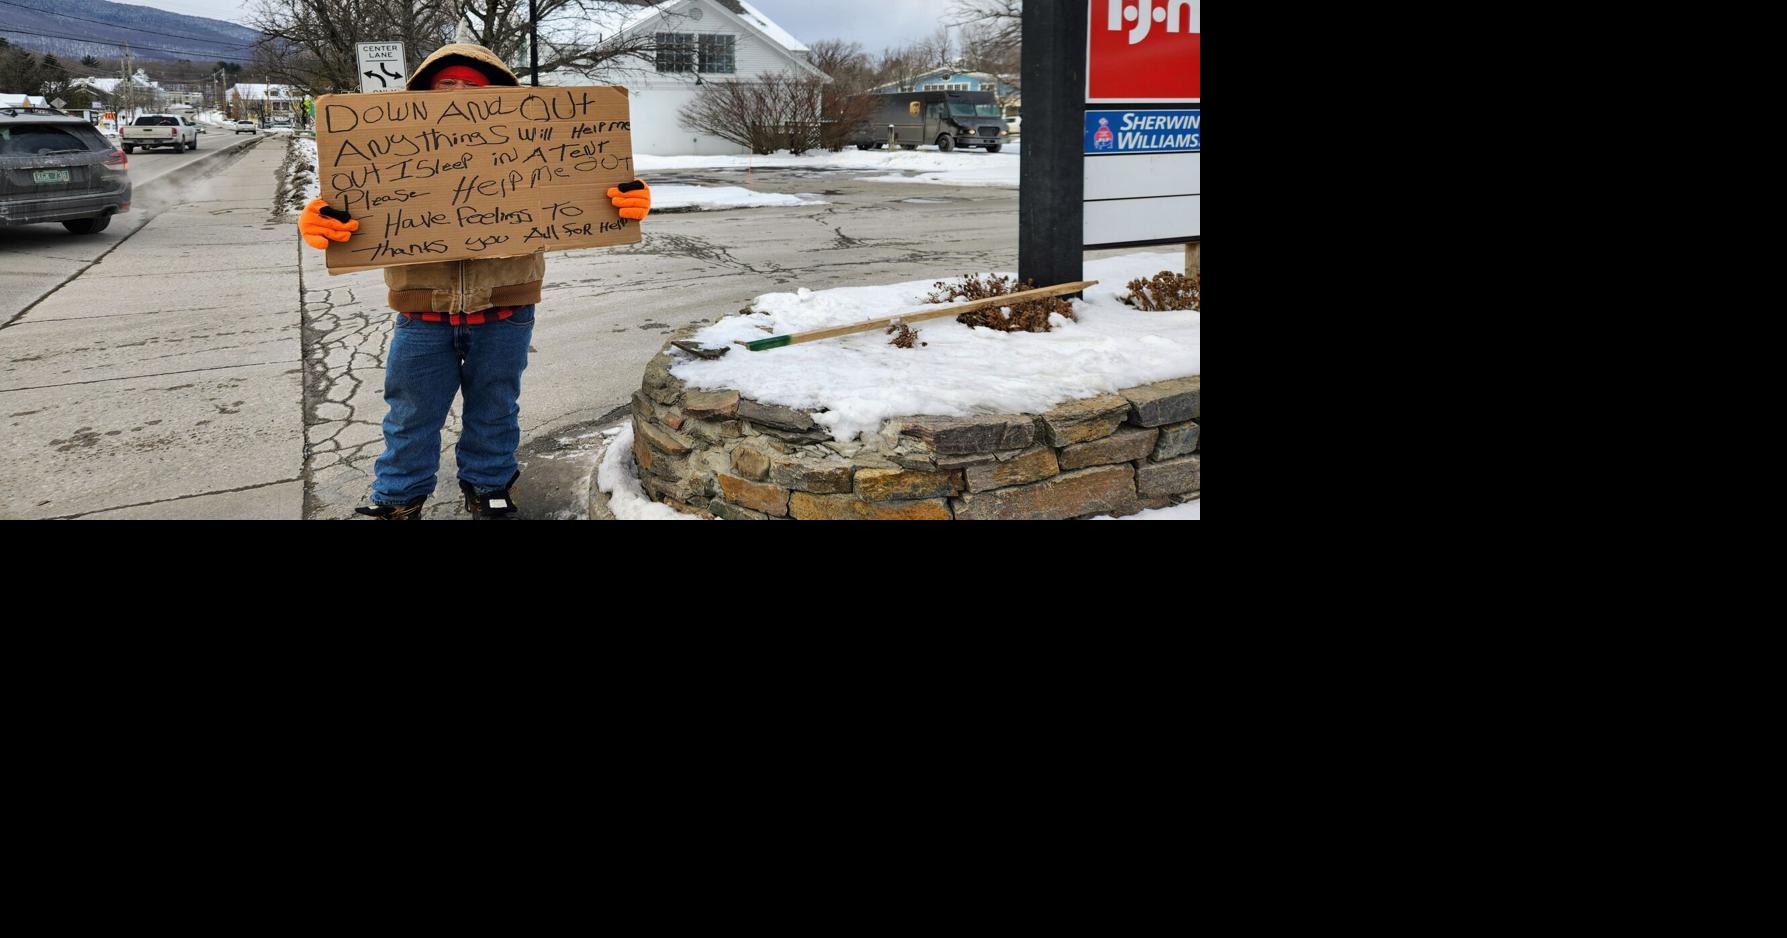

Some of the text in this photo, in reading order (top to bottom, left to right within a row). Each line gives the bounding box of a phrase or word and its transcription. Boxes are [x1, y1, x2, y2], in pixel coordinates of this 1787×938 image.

[326, 101, 428, 133] DOWN
[1119, 113, 1200, 131] SHERWIN
[385, 159, 413, 182] I
[522, 147, 548, 163] A
[335, 188, 431, 213] Please
[385, 209, 451, 238] Have
[465, 235, 509, 250] you
[523, 225, 559, 243] All
